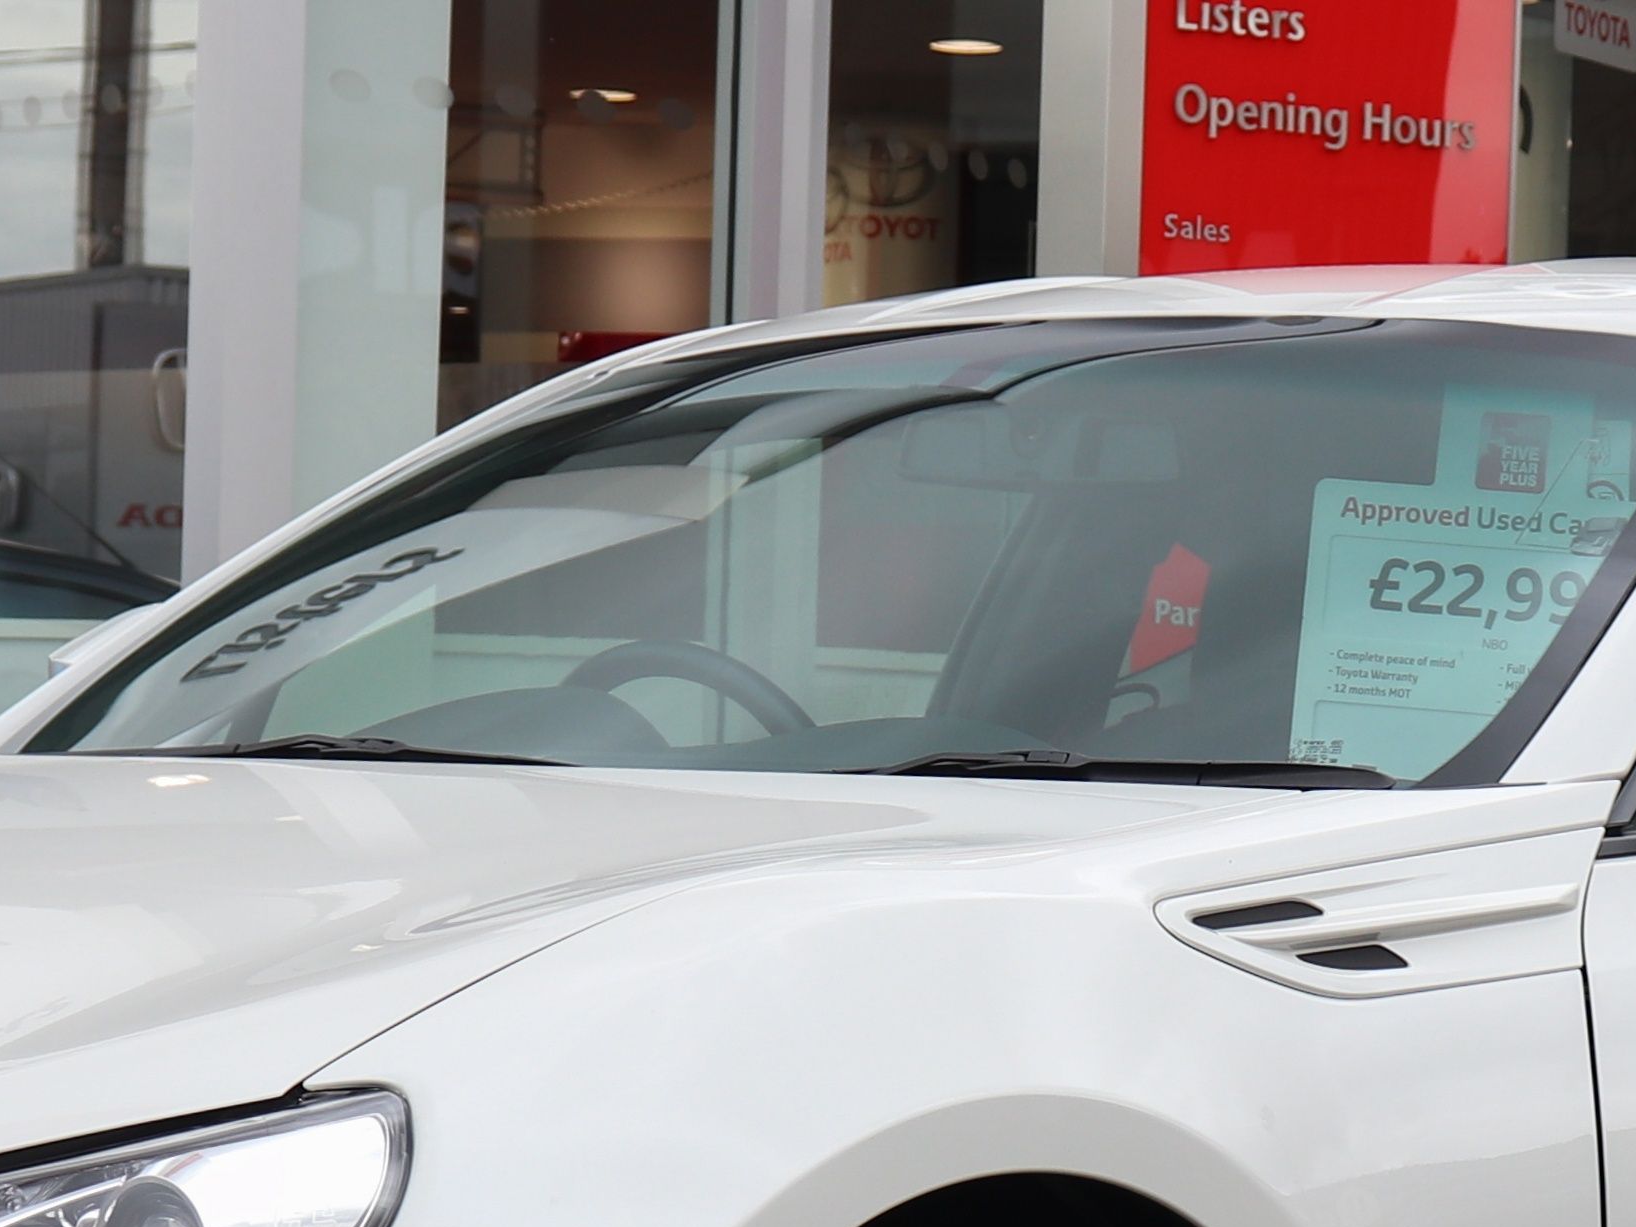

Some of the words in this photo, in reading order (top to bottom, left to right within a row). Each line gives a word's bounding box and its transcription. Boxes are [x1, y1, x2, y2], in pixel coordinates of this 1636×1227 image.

[1175, 0, 1305, 42] Listers
[1565, 1, 1631, 49] TOYOTA
[1174, 83, 1349, 151] Opening
[1363, 101, 1476, 151] Hours
[1164, 213, 1231, 244] Sales
[1501, 445, 1540, 461] FIVE
[1501, 461, 1538, 474] YEAR
[1500, 473, 1537, 487] PLUS
[1341, 496, 1469, 528] Approved
[1477, 507, 1543, 533] Used
[1369, 557, 1588, 630] £22,99
[1482, 638, 1508, 650] NBO
[1336, 649, 1385, 664] Complete
[1386, 654, 1415, 667] peace
[1417, 654, 1429, 667] of
[1429, 656, 1456, 669] mind
[1335, 666, 1369, 679] Toyota
[1371, 669, 1418, 684] Warranty
[1506, 663, 1526, 675] Full
[1334, 683, 1347, 694] 12
[1348, 685, 1386, 698] months
[1388, 687, 1412, 699] MOT
